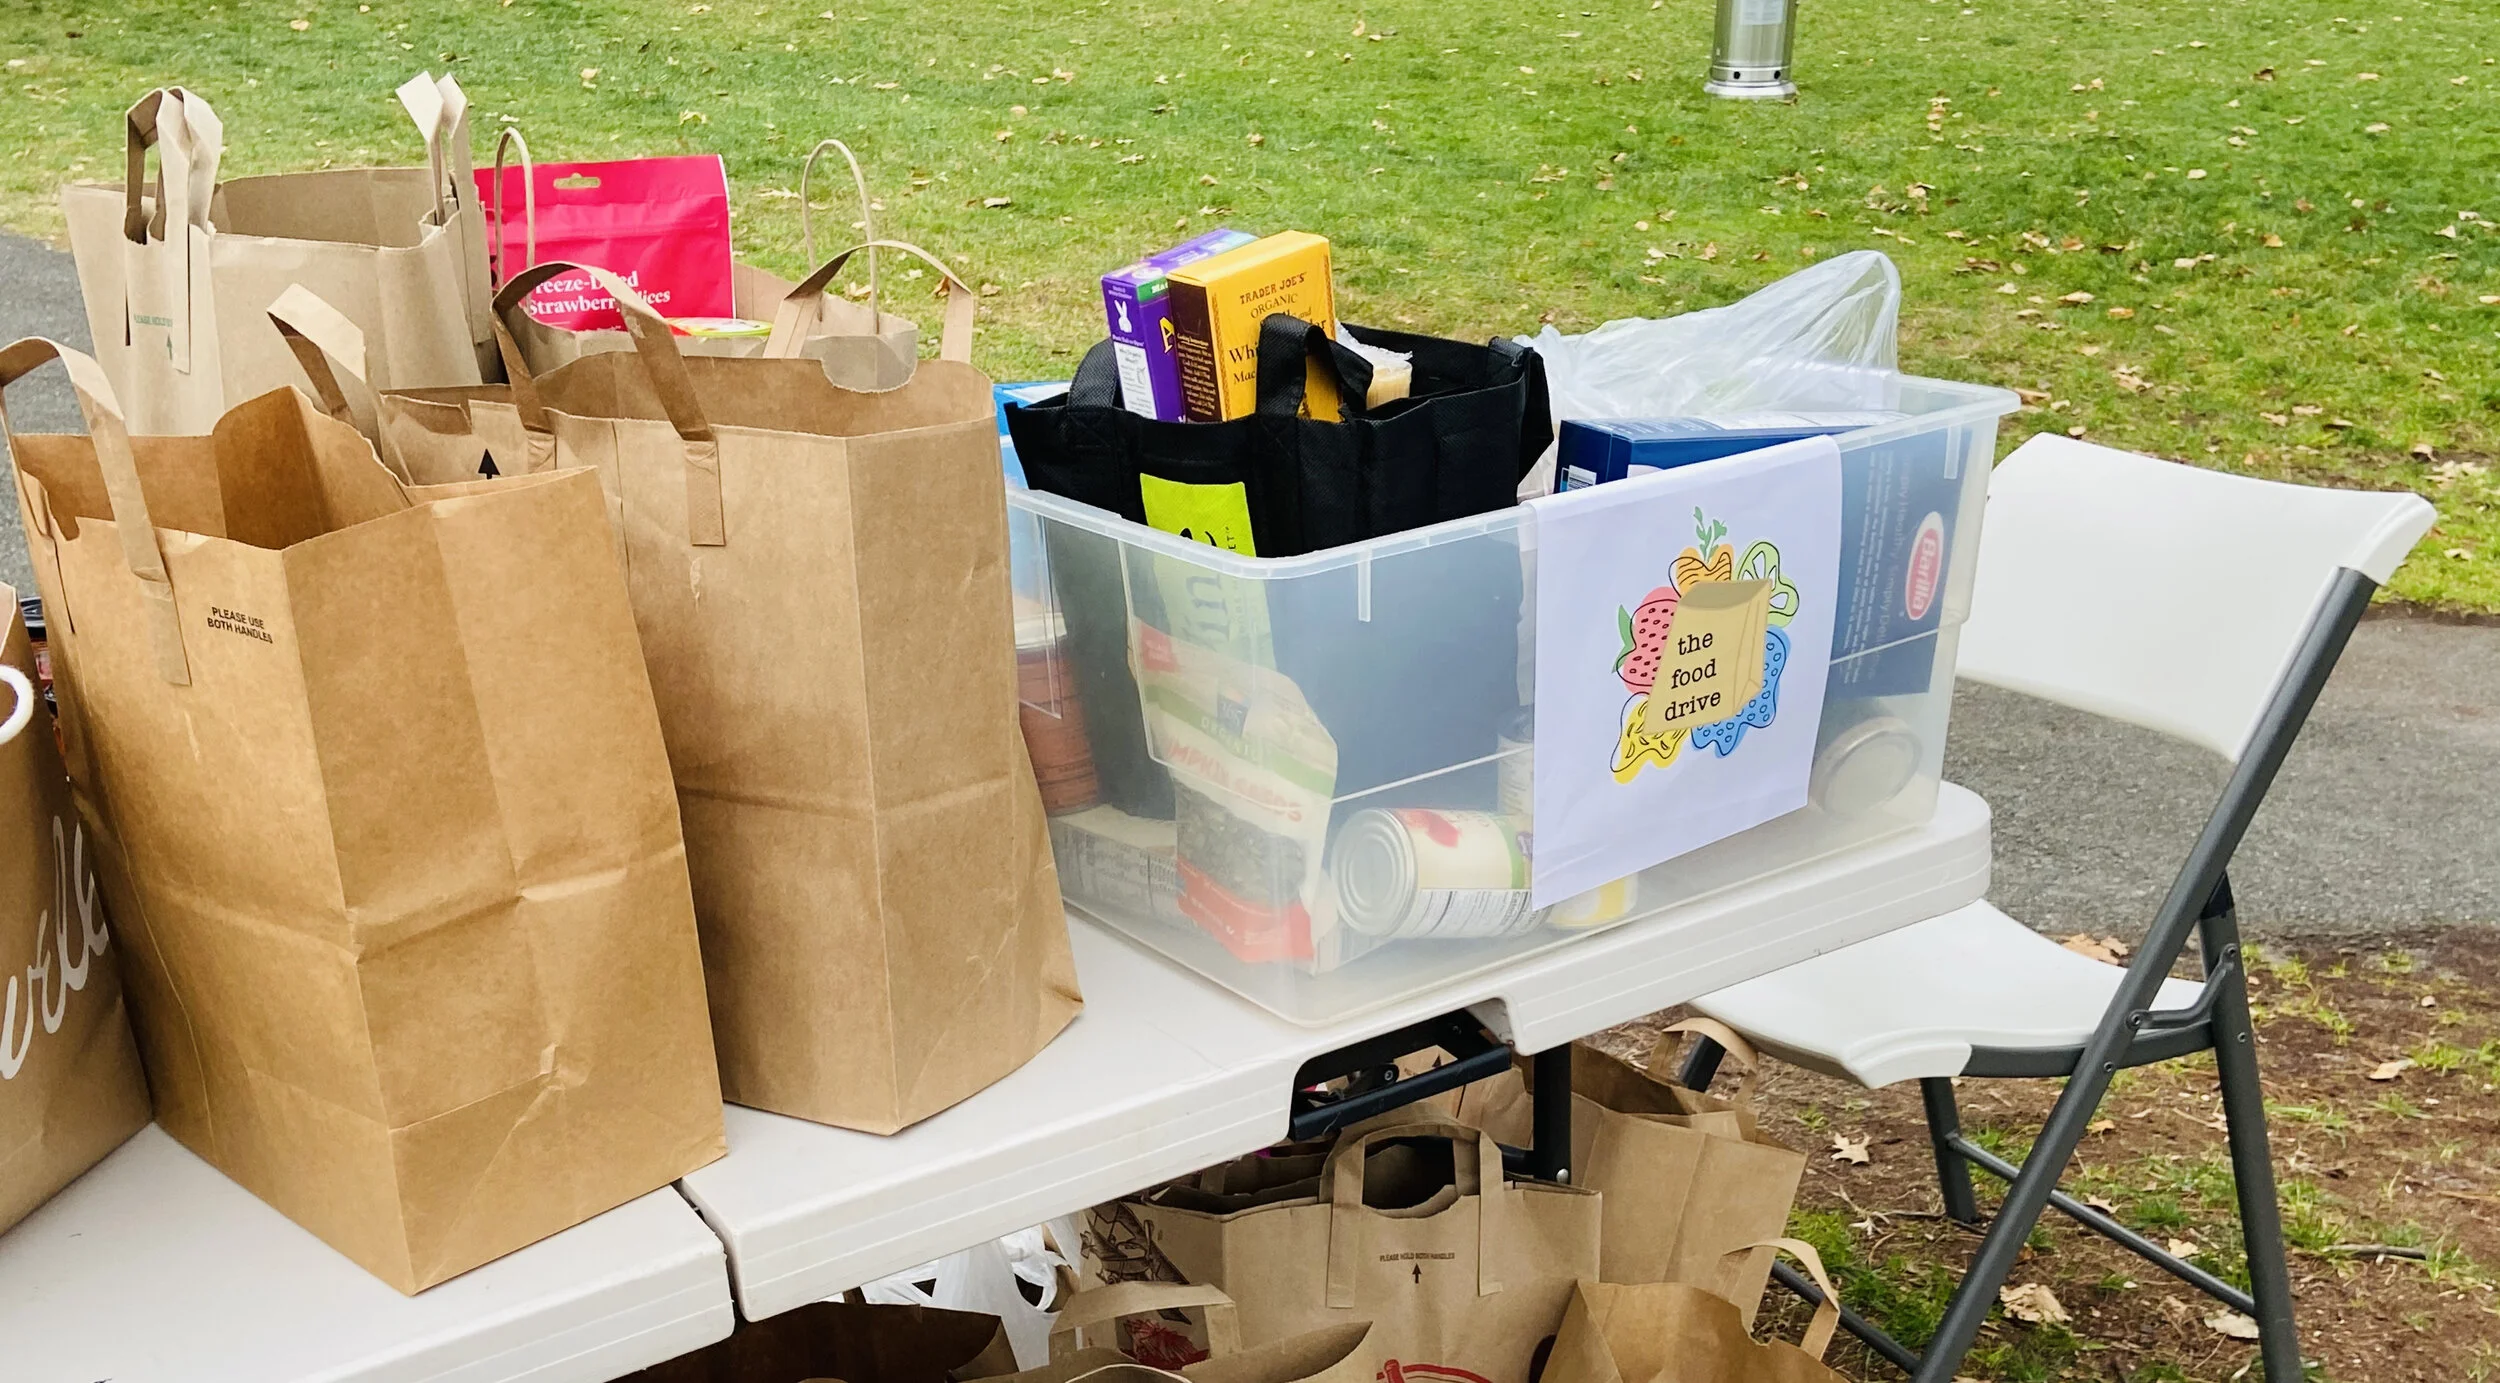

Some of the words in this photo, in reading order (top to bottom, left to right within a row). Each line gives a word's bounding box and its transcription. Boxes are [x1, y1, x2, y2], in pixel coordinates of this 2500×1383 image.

[534, 270, 639, 295] reeze-Ded
[1240, 283, 1277, 305] TRADER
[1280, 272, 1306, 291] JOE'S
[529, 295, 622, 317] Strawberr
[637, 289, 671, 305] lices
[1250, 293, 1298, 319] ORGANIC
[1229, 341, 1258, 364] Whi
[1912, 537, 1937, 611] Barilla
[207, 617, 233, 632] BOTH
[234, 624, 273, 645] HANDLES
[211, 606, 247, 624] PLEASE
[248, 615, 265, 630] USE
[1677, 632, 1714, 656] the
[1670, 658, 1717, 690] food
[1664, 691, 1721, 722] drive
[1380, 1252, 1399, 1262] PLEASE
